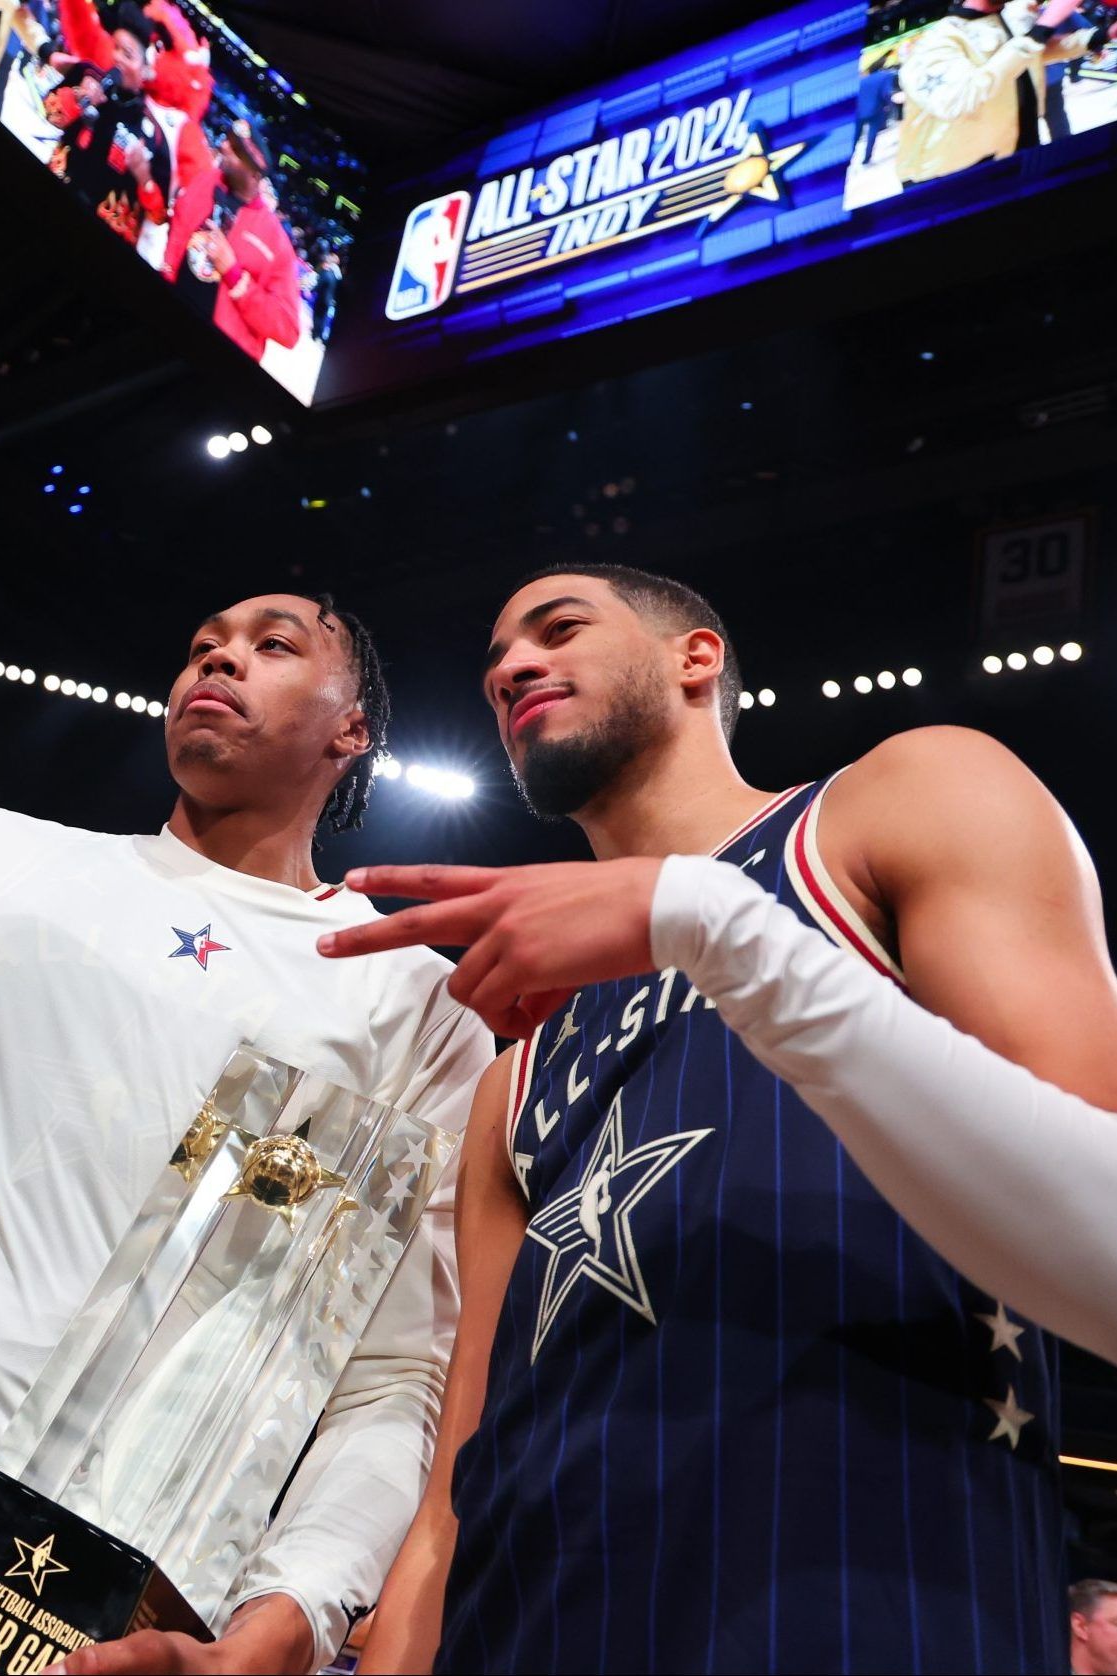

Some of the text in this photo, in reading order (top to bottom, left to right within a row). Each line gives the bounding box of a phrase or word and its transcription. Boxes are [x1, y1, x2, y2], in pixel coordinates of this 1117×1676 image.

[648, 88, 754, 180] 2024
[545, 190, 662, 257] INDY
[999, 529, 1069, 584] 30
[7, 1632, 67, 1674] GA
[32, 1608, 99, 1651] ASSOCIATI
